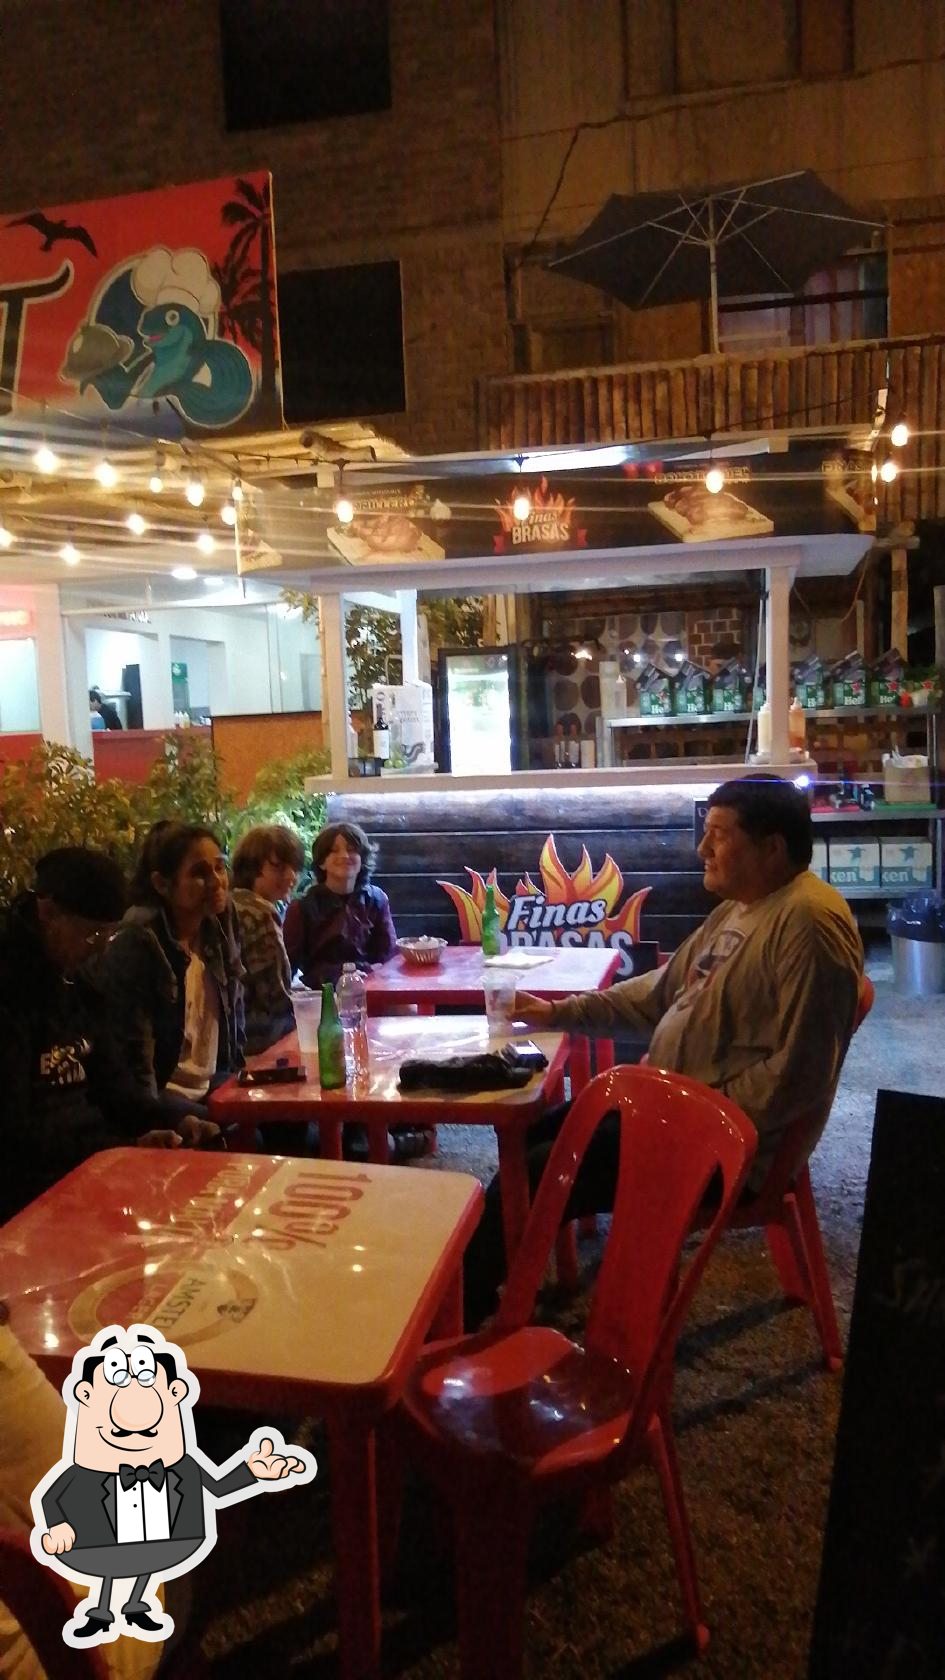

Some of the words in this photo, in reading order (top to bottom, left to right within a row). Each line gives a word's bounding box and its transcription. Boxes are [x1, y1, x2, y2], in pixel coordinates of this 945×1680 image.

[512, 523, 570, 544] BRASAS
[507, 895, 607, 931] Finas
[243, 1172, 373, 1250] 100%
